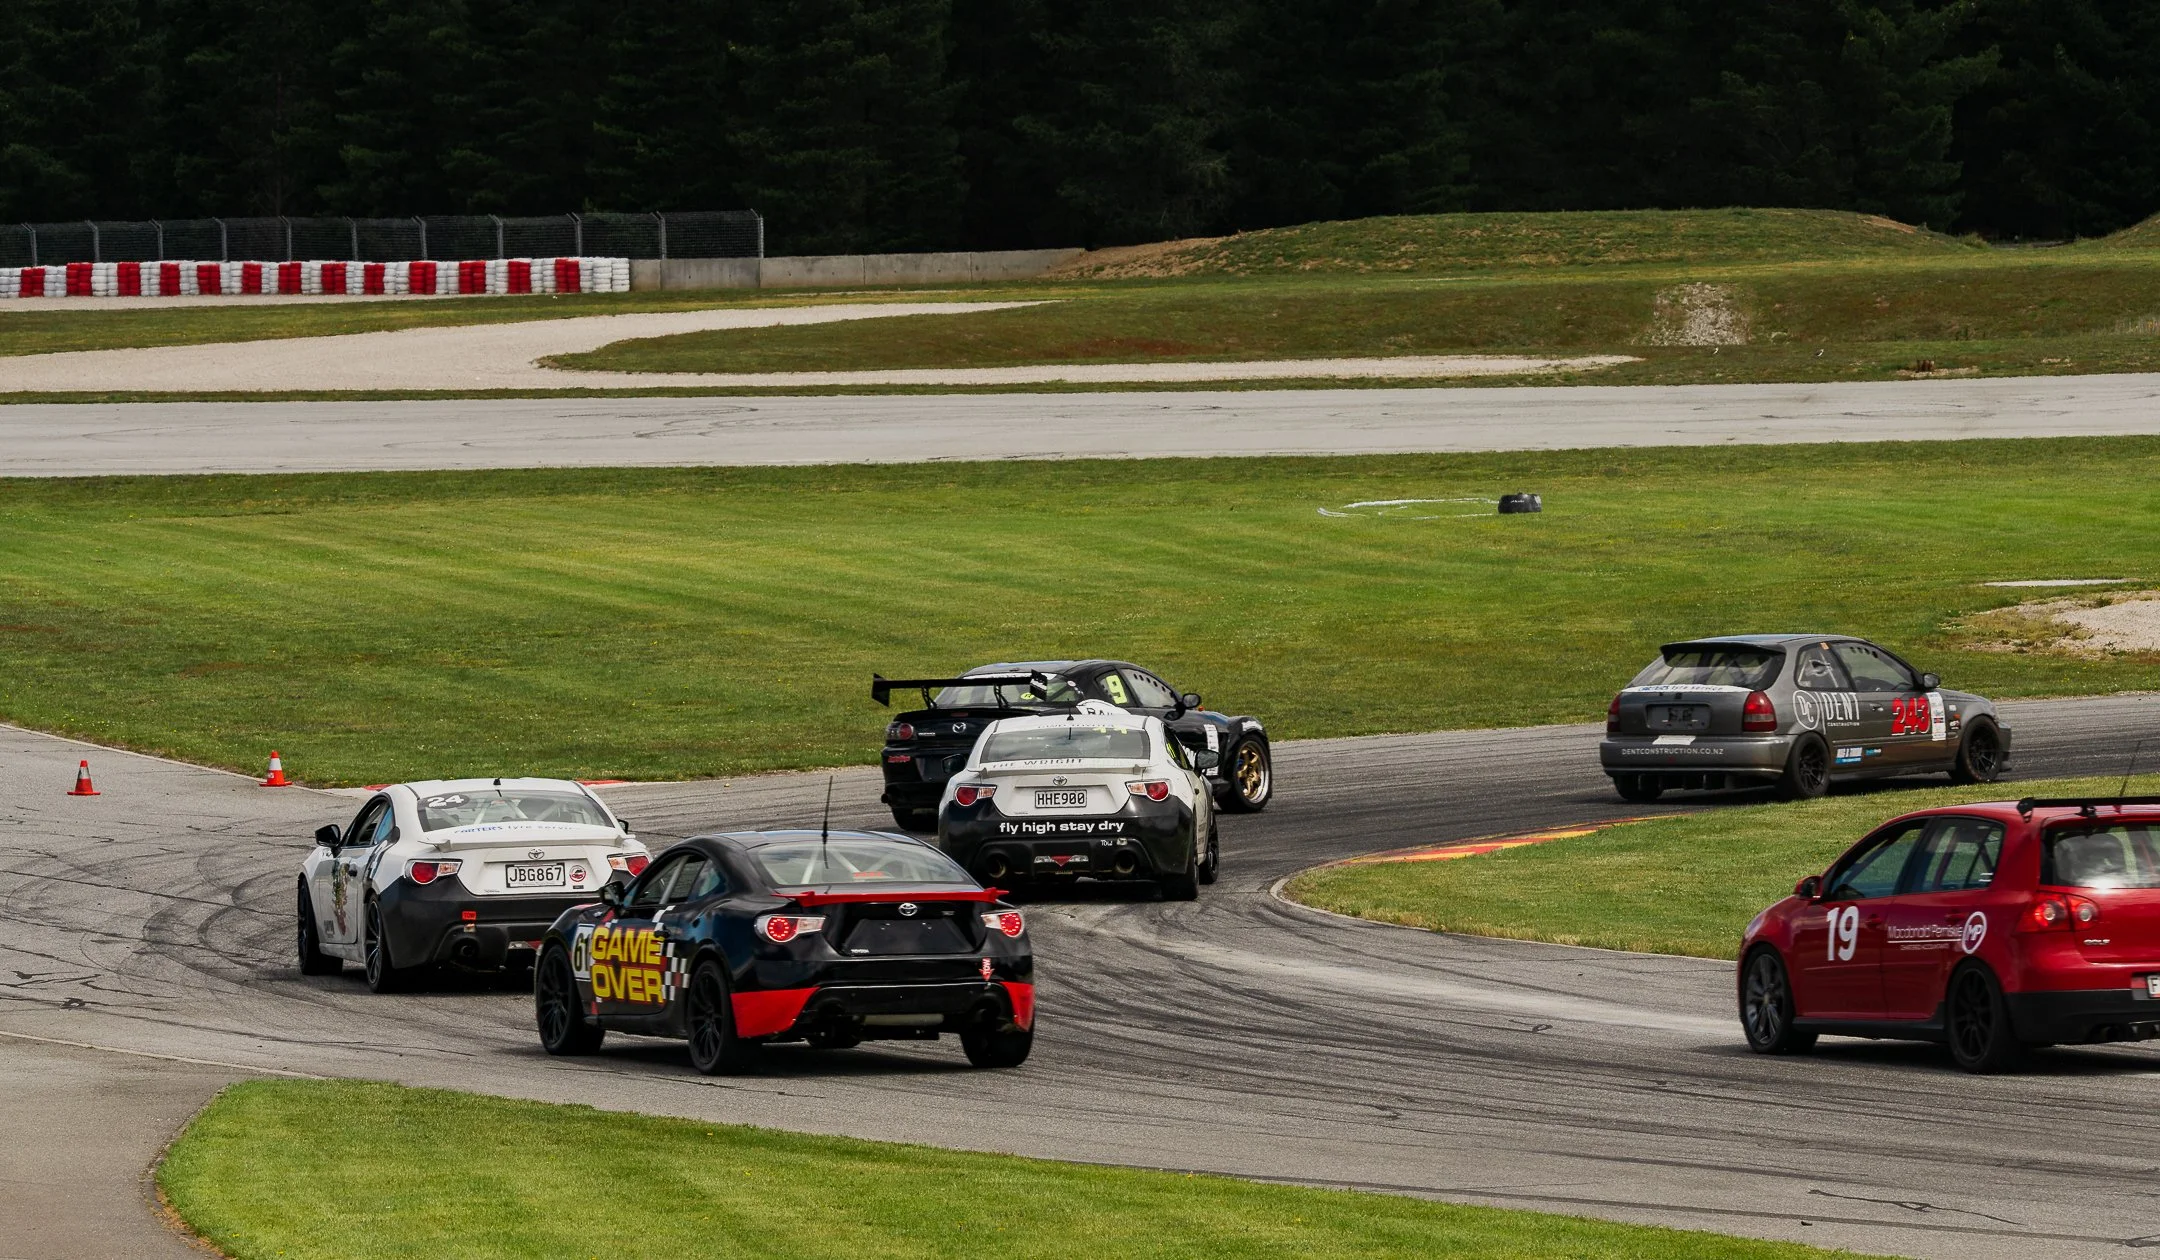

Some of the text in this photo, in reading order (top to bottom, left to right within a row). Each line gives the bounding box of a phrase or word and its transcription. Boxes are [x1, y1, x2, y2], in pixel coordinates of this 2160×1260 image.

[1821, 691, 1860, 720] DENT
[1891, 696, 1931, 736] 243
[1621, 747, 1724, 755] DENTCONSTRUCTION.CO.NZ
[427, 795, 465, 807] 24
[1037, 792, 1085, 805] HHE900
[1000, 820, 1124, 835] fly high stay dry
[509, 867, 562, 882] JBG867
[1826, 906, 1859, 961] 19
[592, 926, 665, 965] GAME
[591, 964, 665, 1003] OVER
